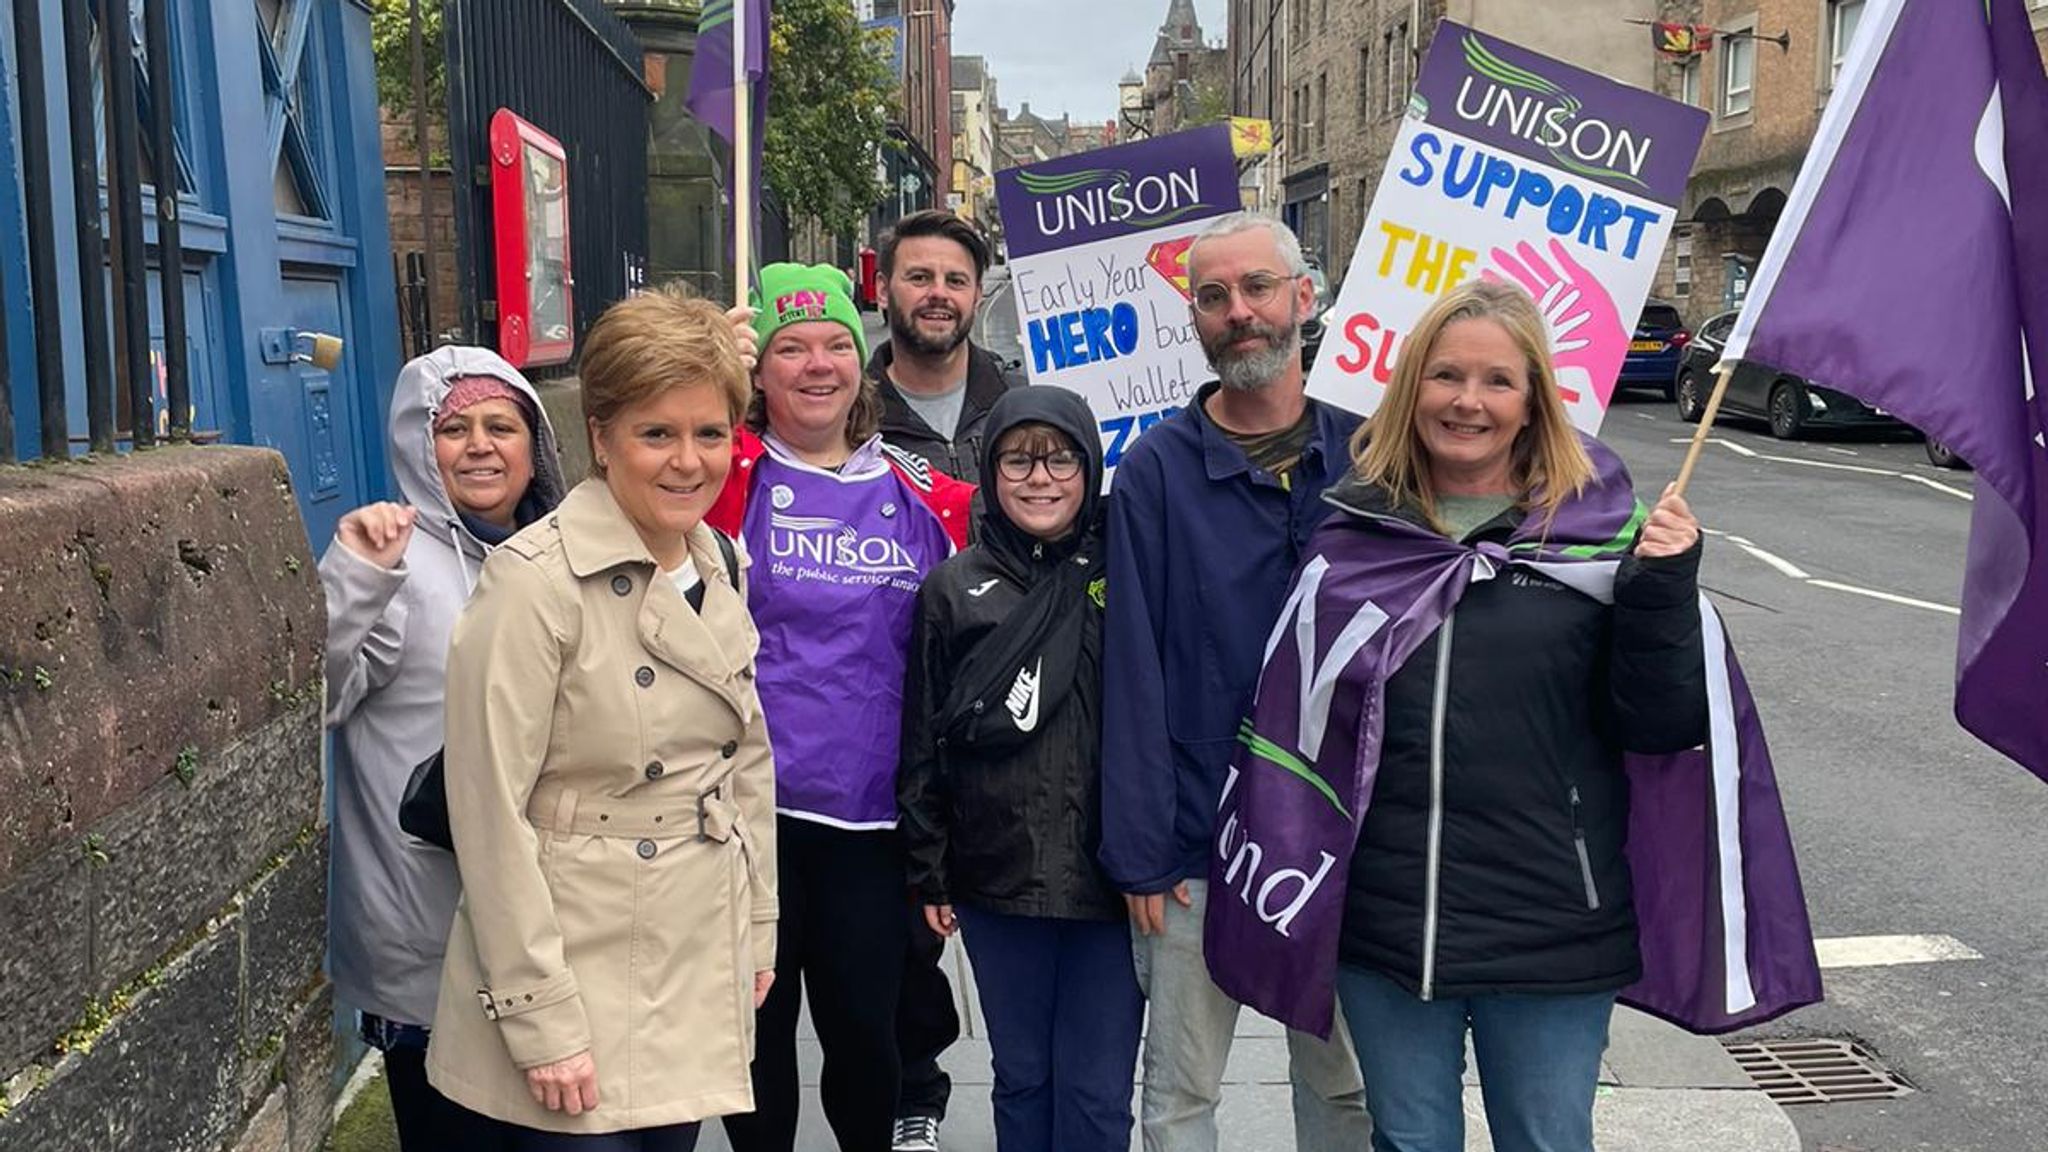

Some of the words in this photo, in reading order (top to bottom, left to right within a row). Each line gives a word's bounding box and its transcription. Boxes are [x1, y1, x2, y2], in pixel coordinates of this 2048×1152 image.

[1455, 76, 1652, 176] UNISON
[1036, 168, 1200, 235] UNISON
[1400, 132, 1661, 260] SUPPORT
[1377, 219, 1478, 297] THE
[775, 290, 827, 315] PAY
[1017, 262, 1096, 315] Early
[1027, 302, 1138, 374] HERO
[770, 529, 917, 569] UNISON
[771, 560, 794, 576] the
[796, 565, 838, 582] public
[841, 572, 890, 586] service
[1004, 666, 1037, 718] NIKE
